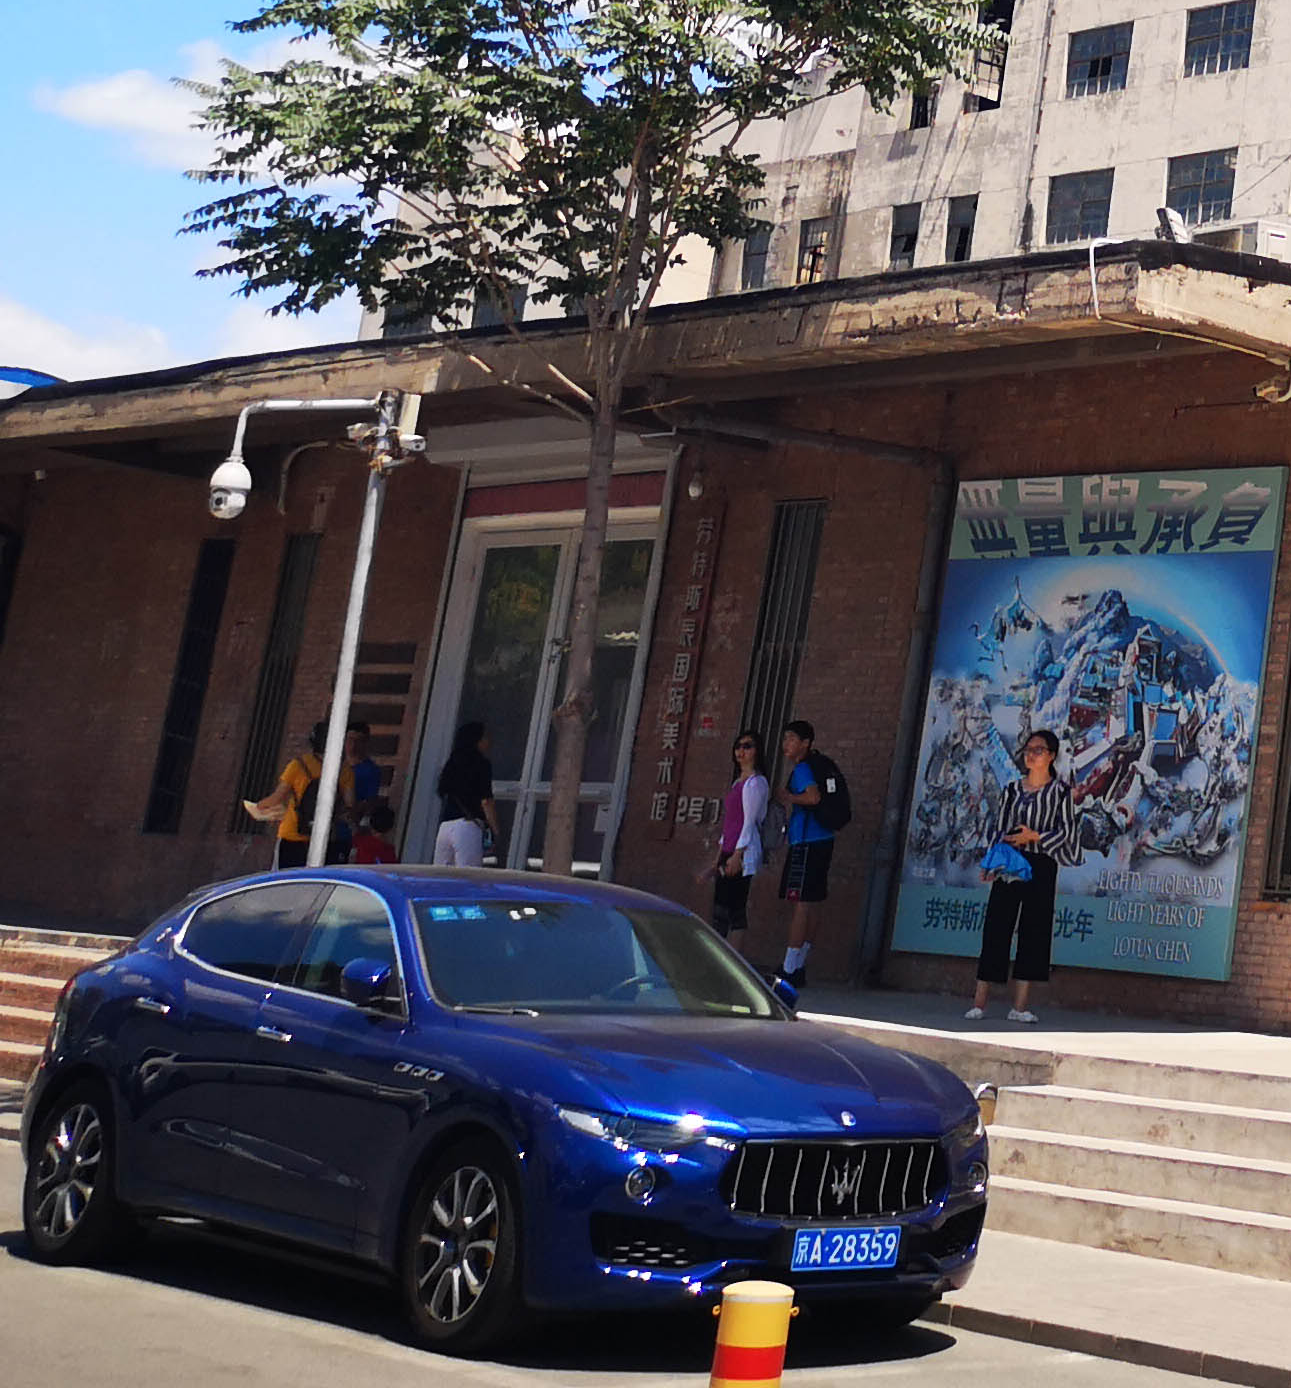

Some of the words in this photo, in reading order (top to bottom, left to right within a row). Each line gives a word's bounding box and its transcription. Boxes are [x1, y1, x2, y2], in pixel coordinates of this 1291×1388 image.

[1098, 868, 1143, 892] EIGHTY
[1147, 871, 1225, 899] THOUSANDS
[1106, 901, 1146, 923] LIGHT
[1150, 904, 1186, 927] YEARS
[1187, 906, 1208, 929] OF
[1113, 935, 1152, 958] LOTUS
[1154, 938, 1192, 963] CHEN
